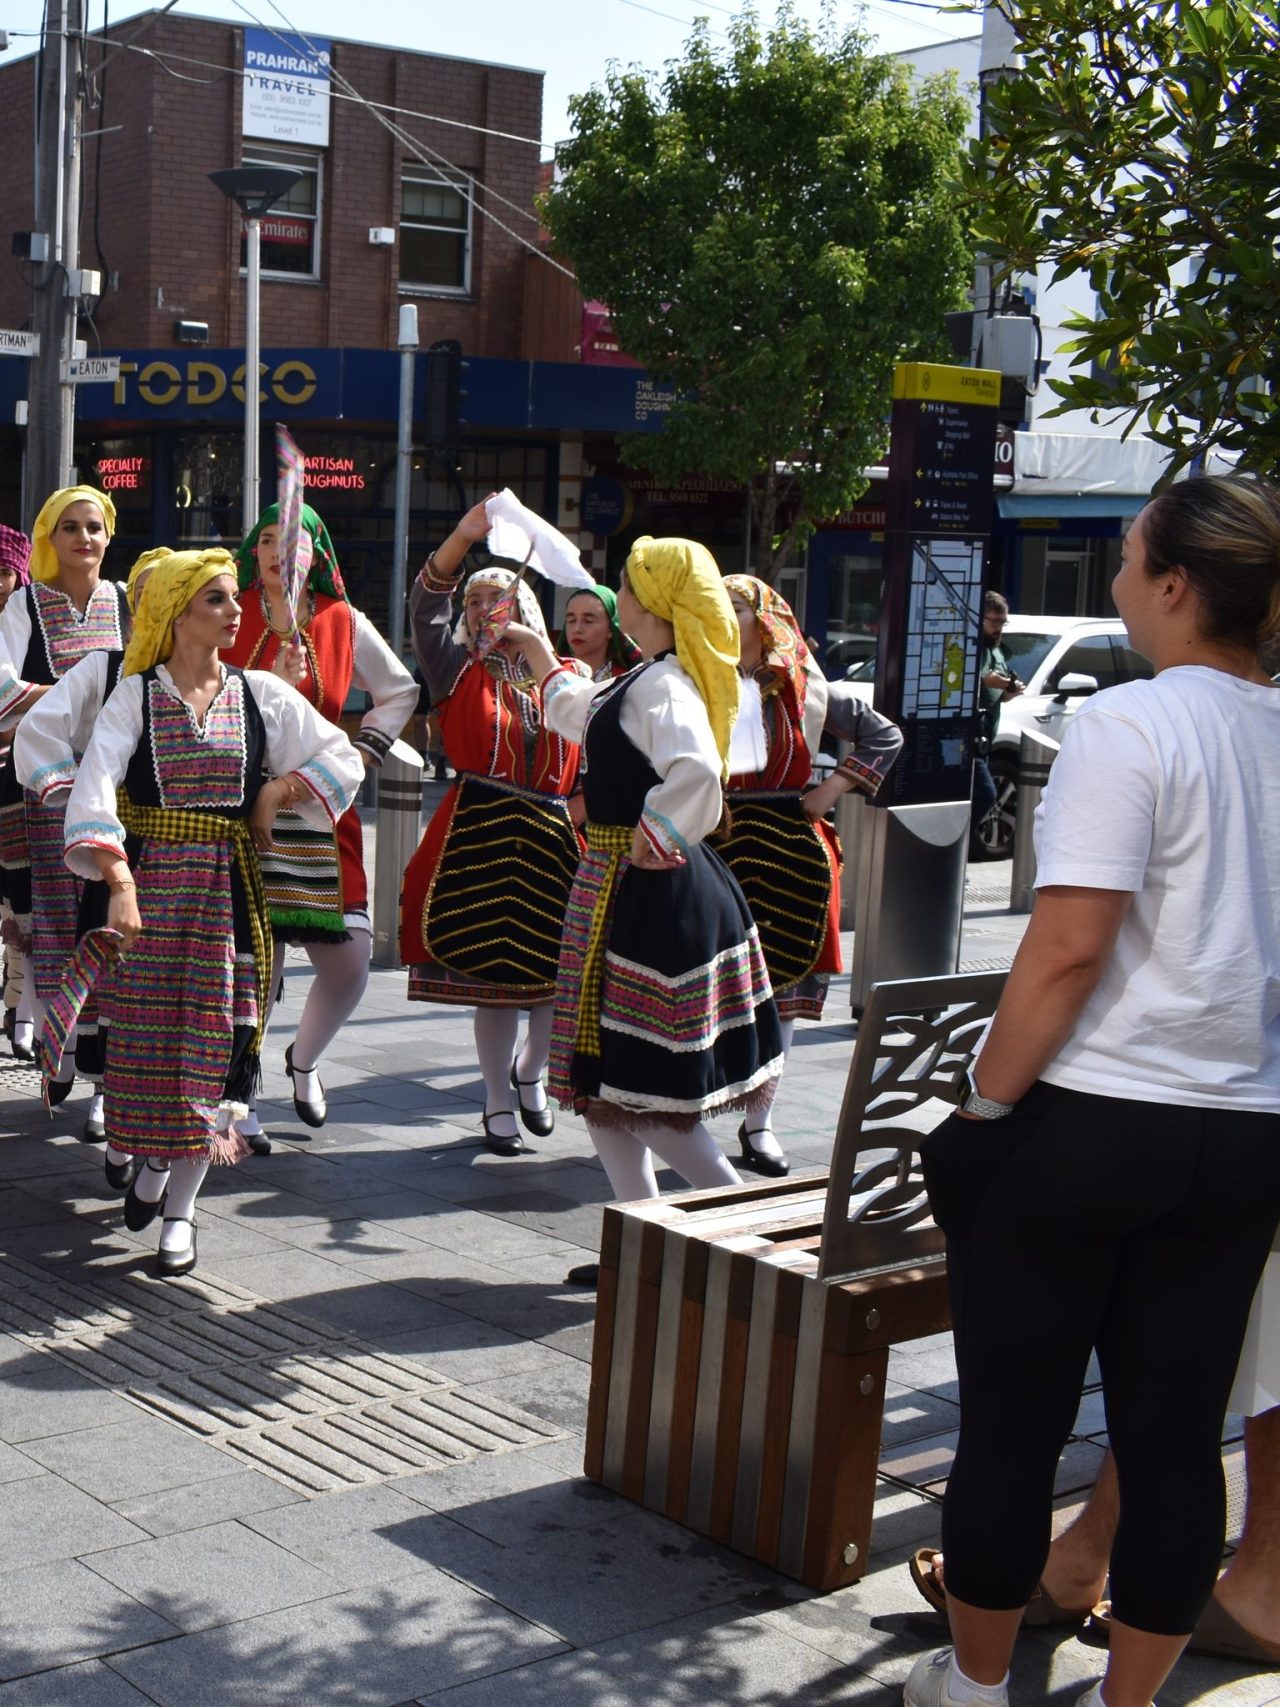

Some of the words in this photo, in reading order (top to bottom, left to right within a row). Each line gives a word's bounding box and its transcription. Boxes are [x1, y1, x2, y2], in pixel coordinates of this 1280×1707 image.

[246, 50, 318, 75] PRAHRAN
[248, 74, 316, 96] TRAVEL
[79, 361, 108, 375] EATON
[114, 360, 317, 405] TODCO
[636, 381, 654, 390] THE
[98, 457, 143, 473] SPECIALTY
[303, 456, 354, 471] ARTISAN
[103, 474, 138, 489] COFFEE
[302, 473, 365, 489] OUGHNUTS
